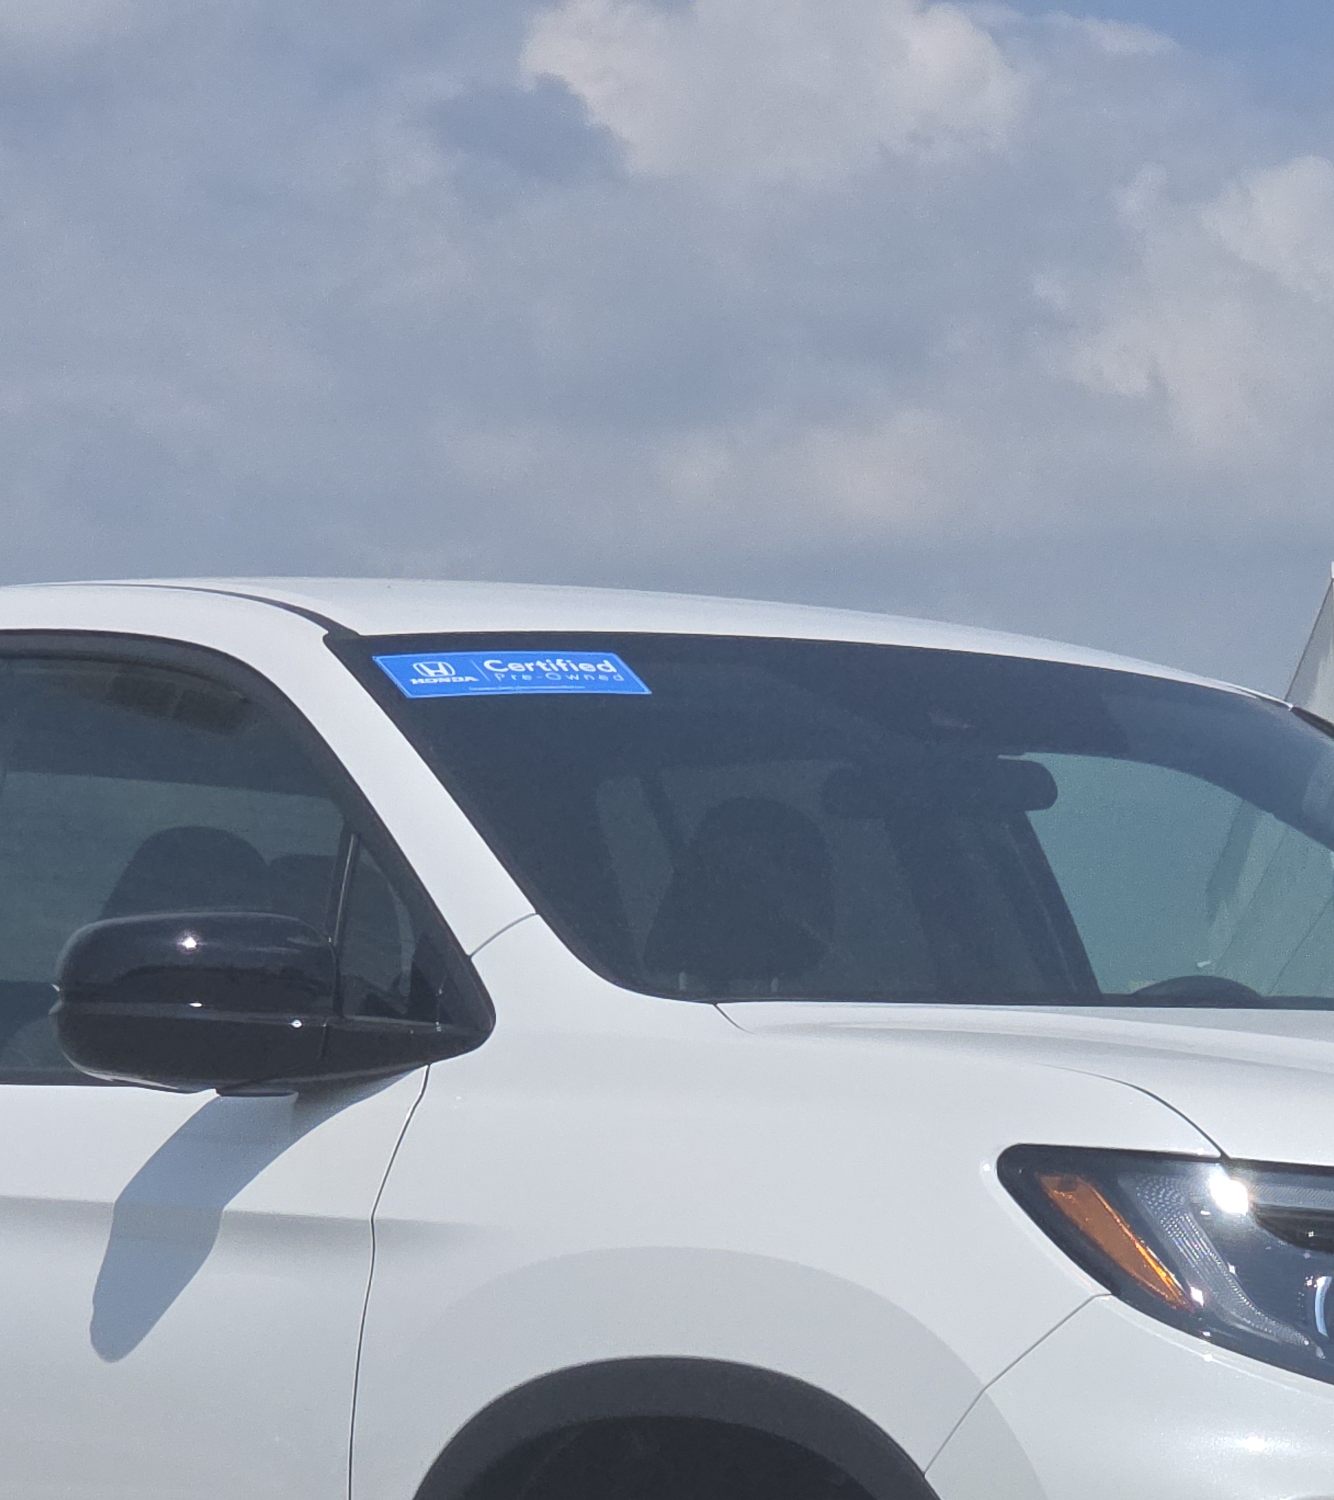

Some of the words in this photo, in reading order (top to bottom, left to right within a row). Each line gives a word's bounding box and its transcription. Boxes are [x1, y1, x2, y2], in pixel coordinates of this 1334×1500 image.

[483, 658, 618, 673] Certified
[410, 676, 479, 685] HONDA
[494, 672, 625, 682] Pre-Owned
